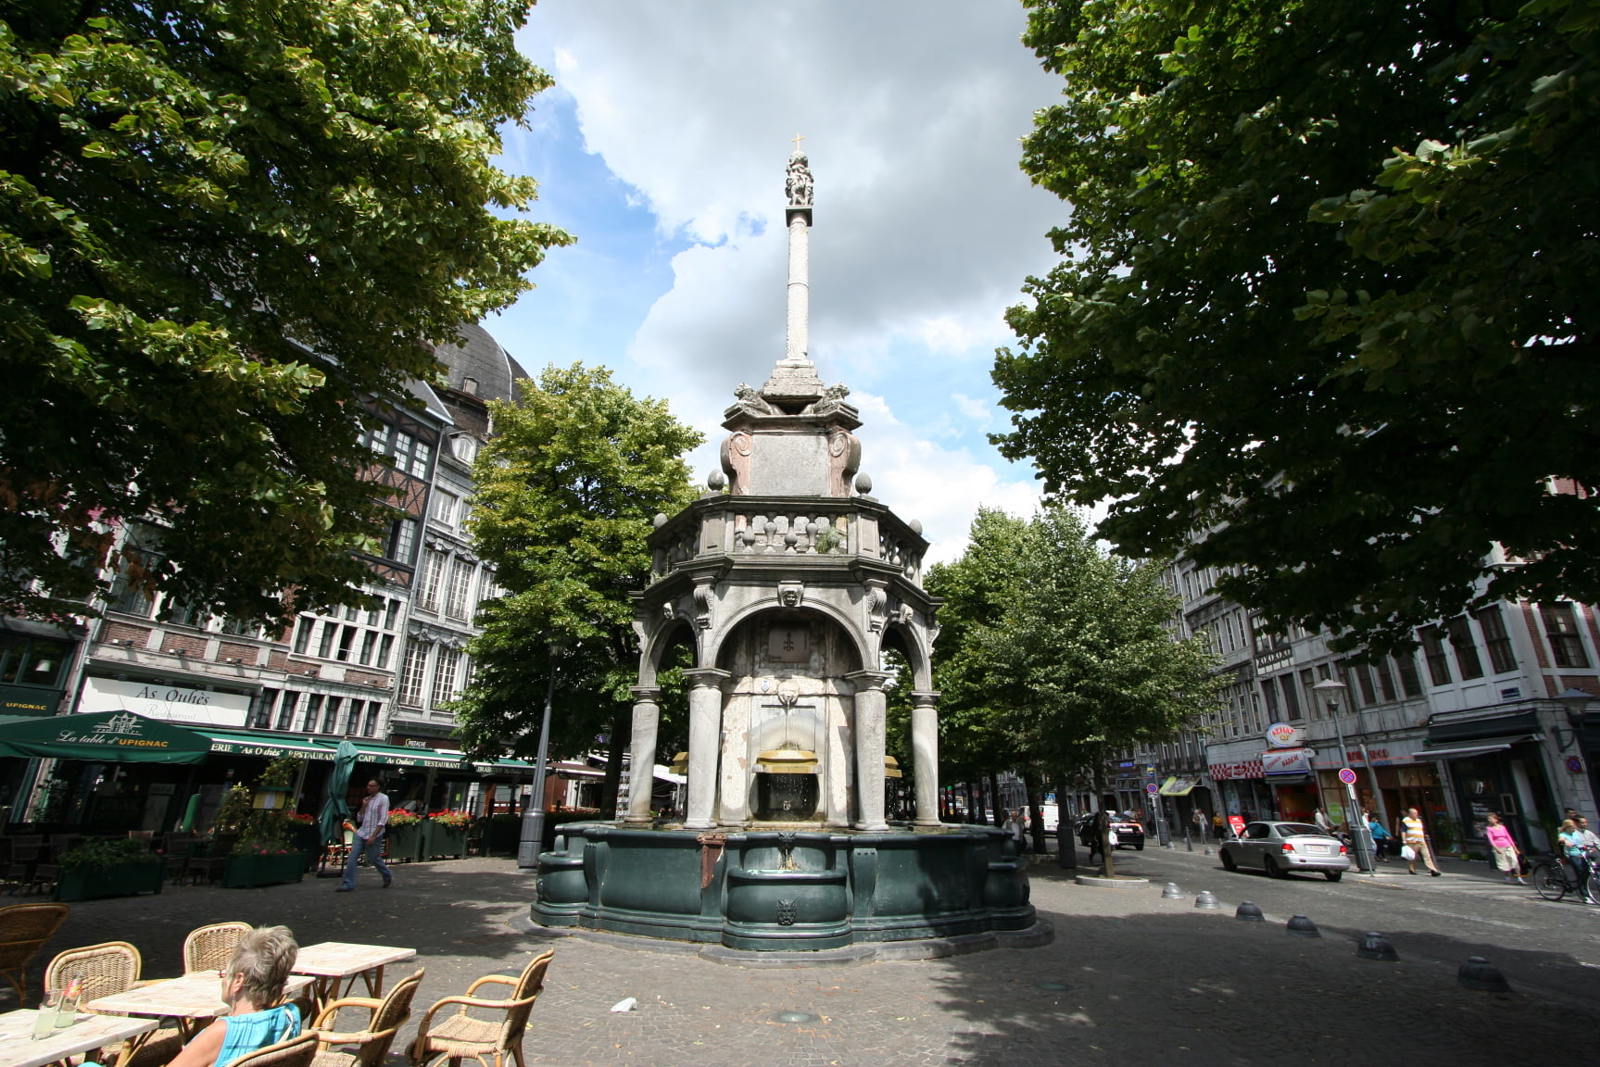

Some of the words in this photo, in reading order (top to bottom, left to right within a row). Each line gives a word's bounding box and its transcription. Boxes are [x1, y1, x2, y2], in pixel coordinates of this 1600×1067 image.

[136, 686, 157, 699] As
[5, 702, 47, 711] UPIGNAC
[56, 730, 78, 743] La
[78, 734, 106, 745] table
[288, 751, 336, 761] RESTAURAN
